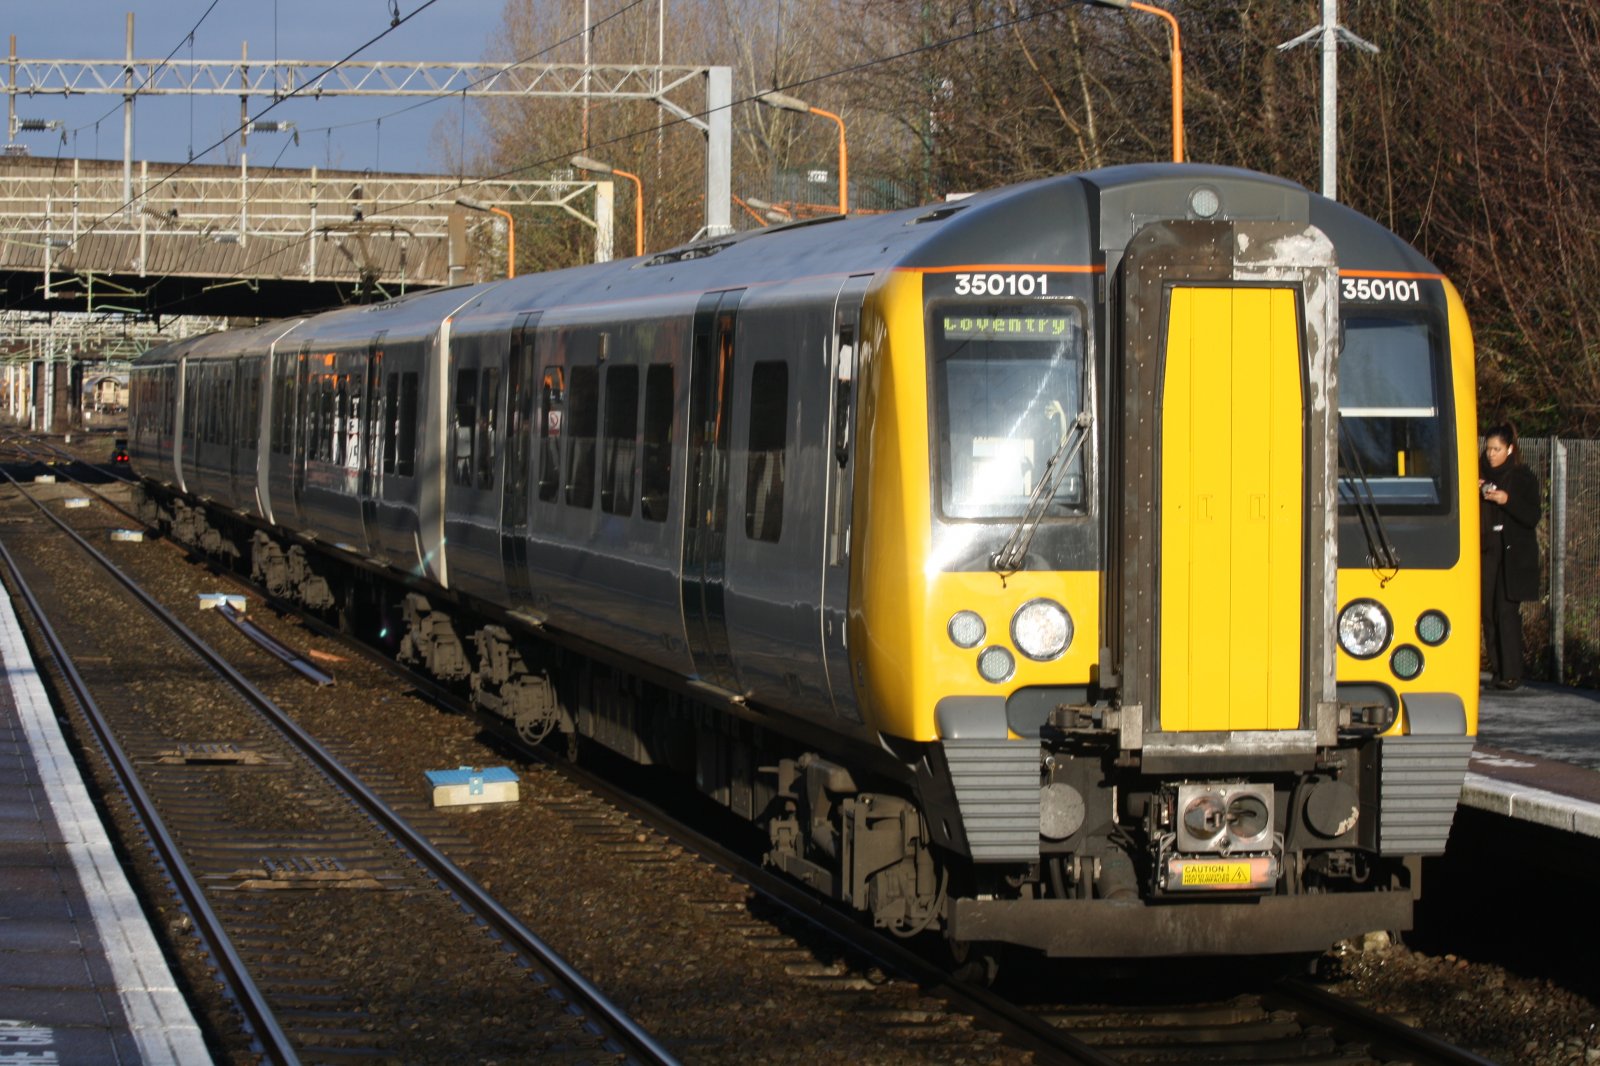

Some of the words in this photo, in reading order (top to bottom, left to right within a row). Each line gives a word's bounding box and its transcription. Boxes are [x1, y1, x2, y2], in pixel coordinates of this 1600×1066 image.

[954, 273, 1048, 296] 350101
[1341, 278, 1420, 302] 350101
[1184, 865, 1224, 873] CAUTION
